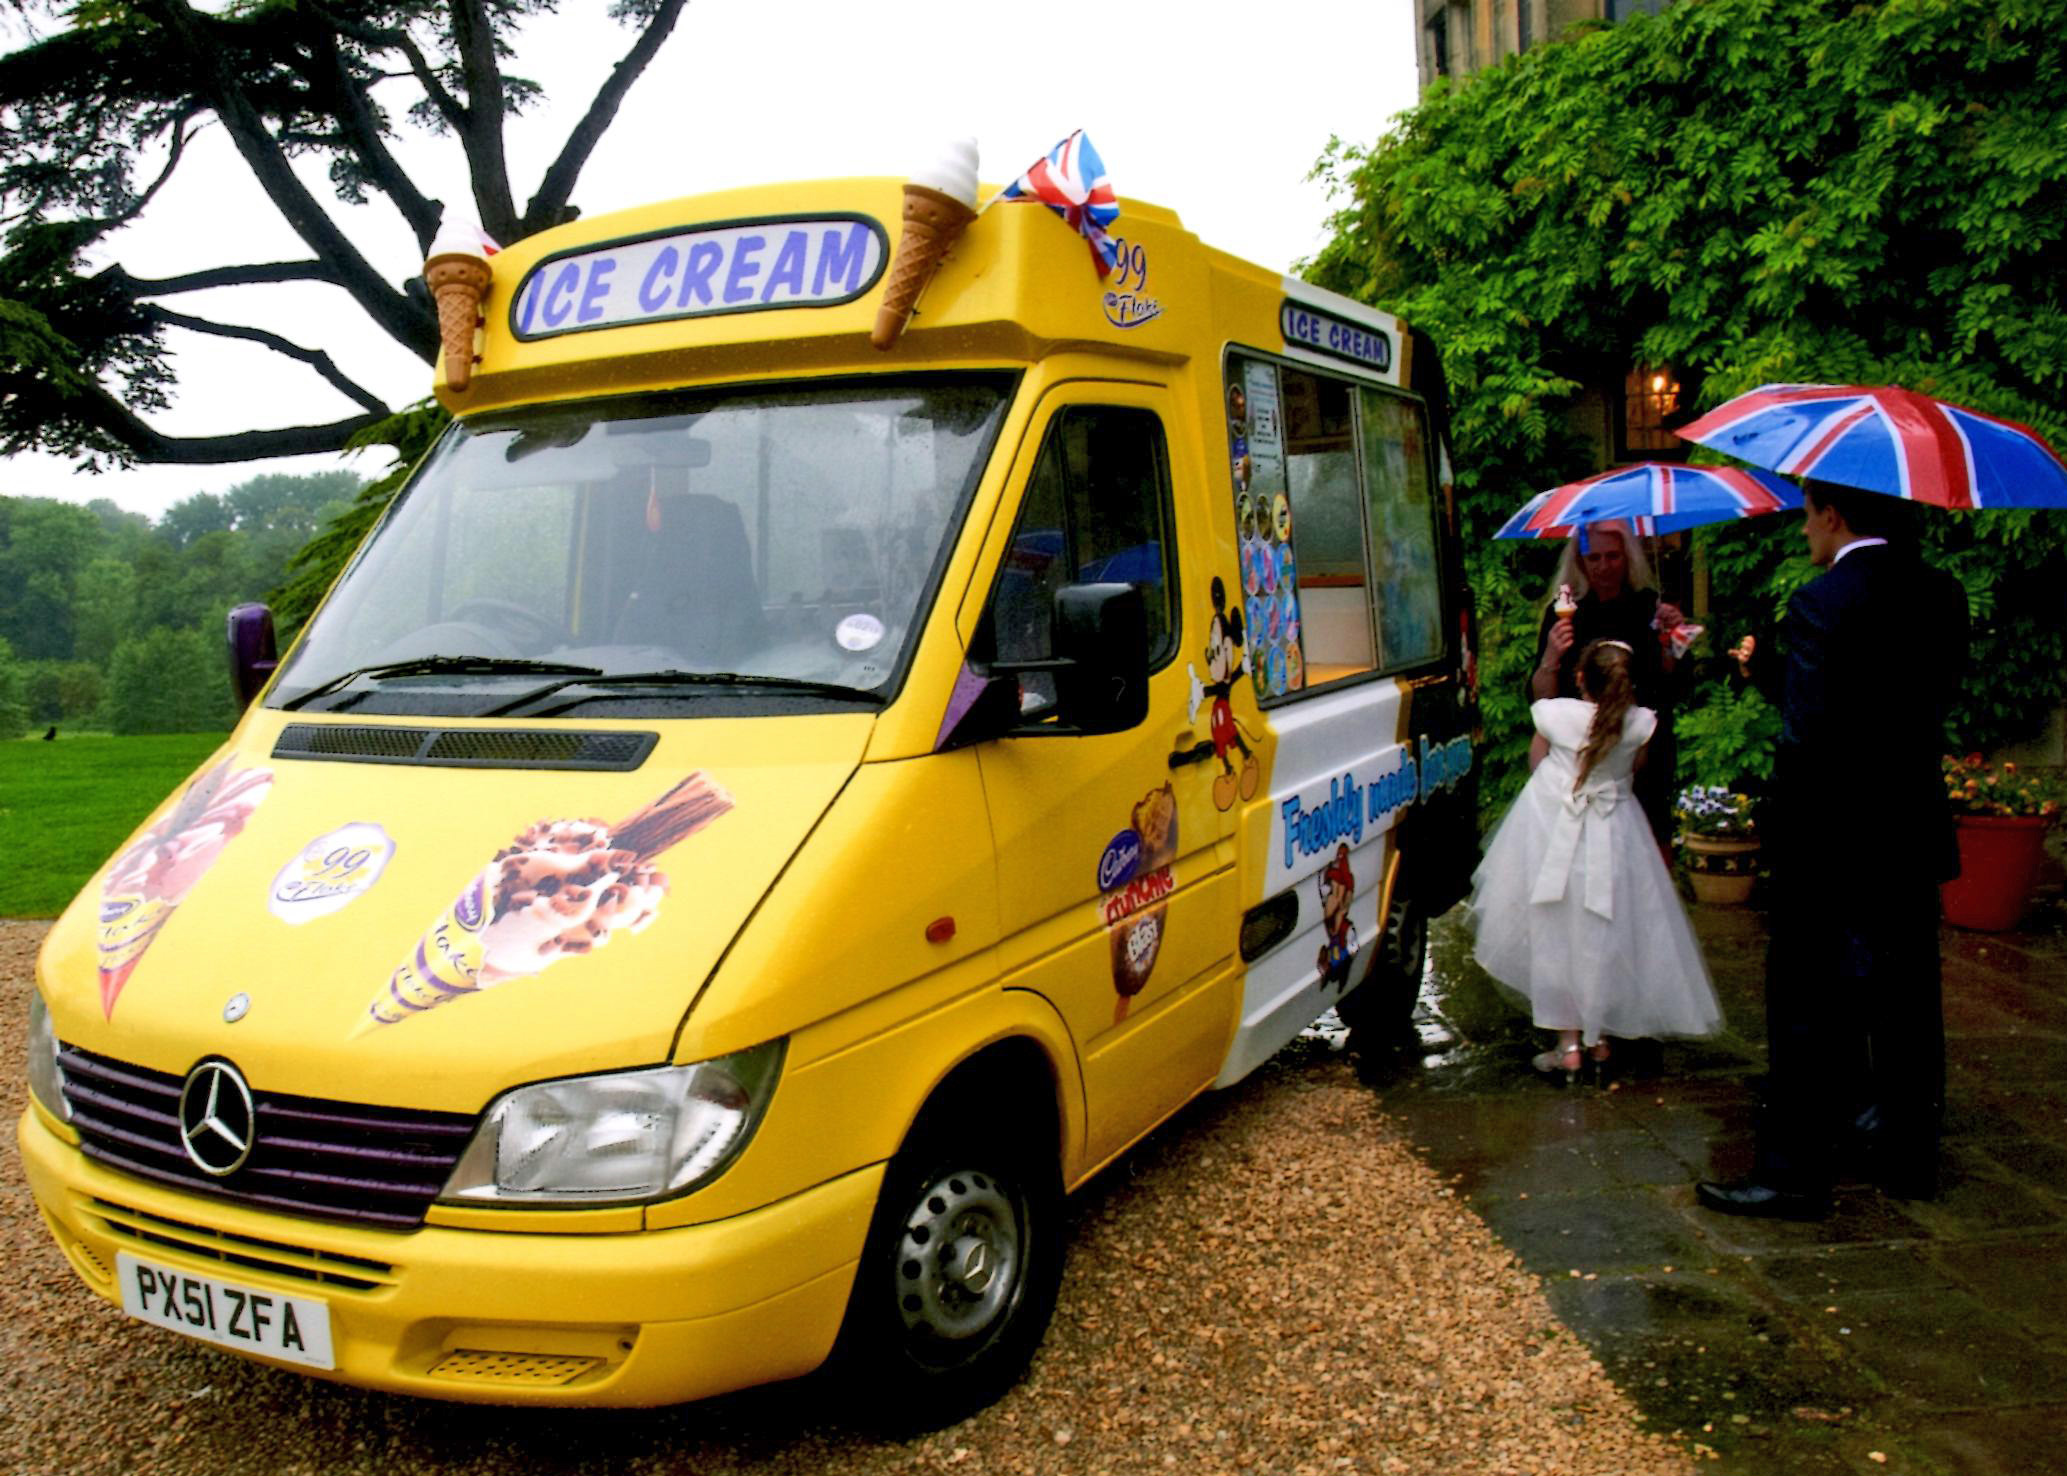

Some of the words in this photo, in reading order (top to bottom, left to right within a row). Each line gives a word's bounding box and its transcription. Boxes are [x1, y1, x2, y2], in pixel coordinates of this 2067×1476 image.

[519, 258, 617, 335] ICE
[638, 222, 870, 314] CREAM
[1115, 238, 1146, 291] 99
[1288, 308, 1320, 344] ICE
[1329, 323, 1384, 363] CREAM
[1282, 773, 1364, 869] Freshly
[1369, 748, 1416, 824] made
[312, 846, 371, 879] 99
[136, 1264, 217, 1331] PX51
[224, 1288, 306, 1352] ZFA
